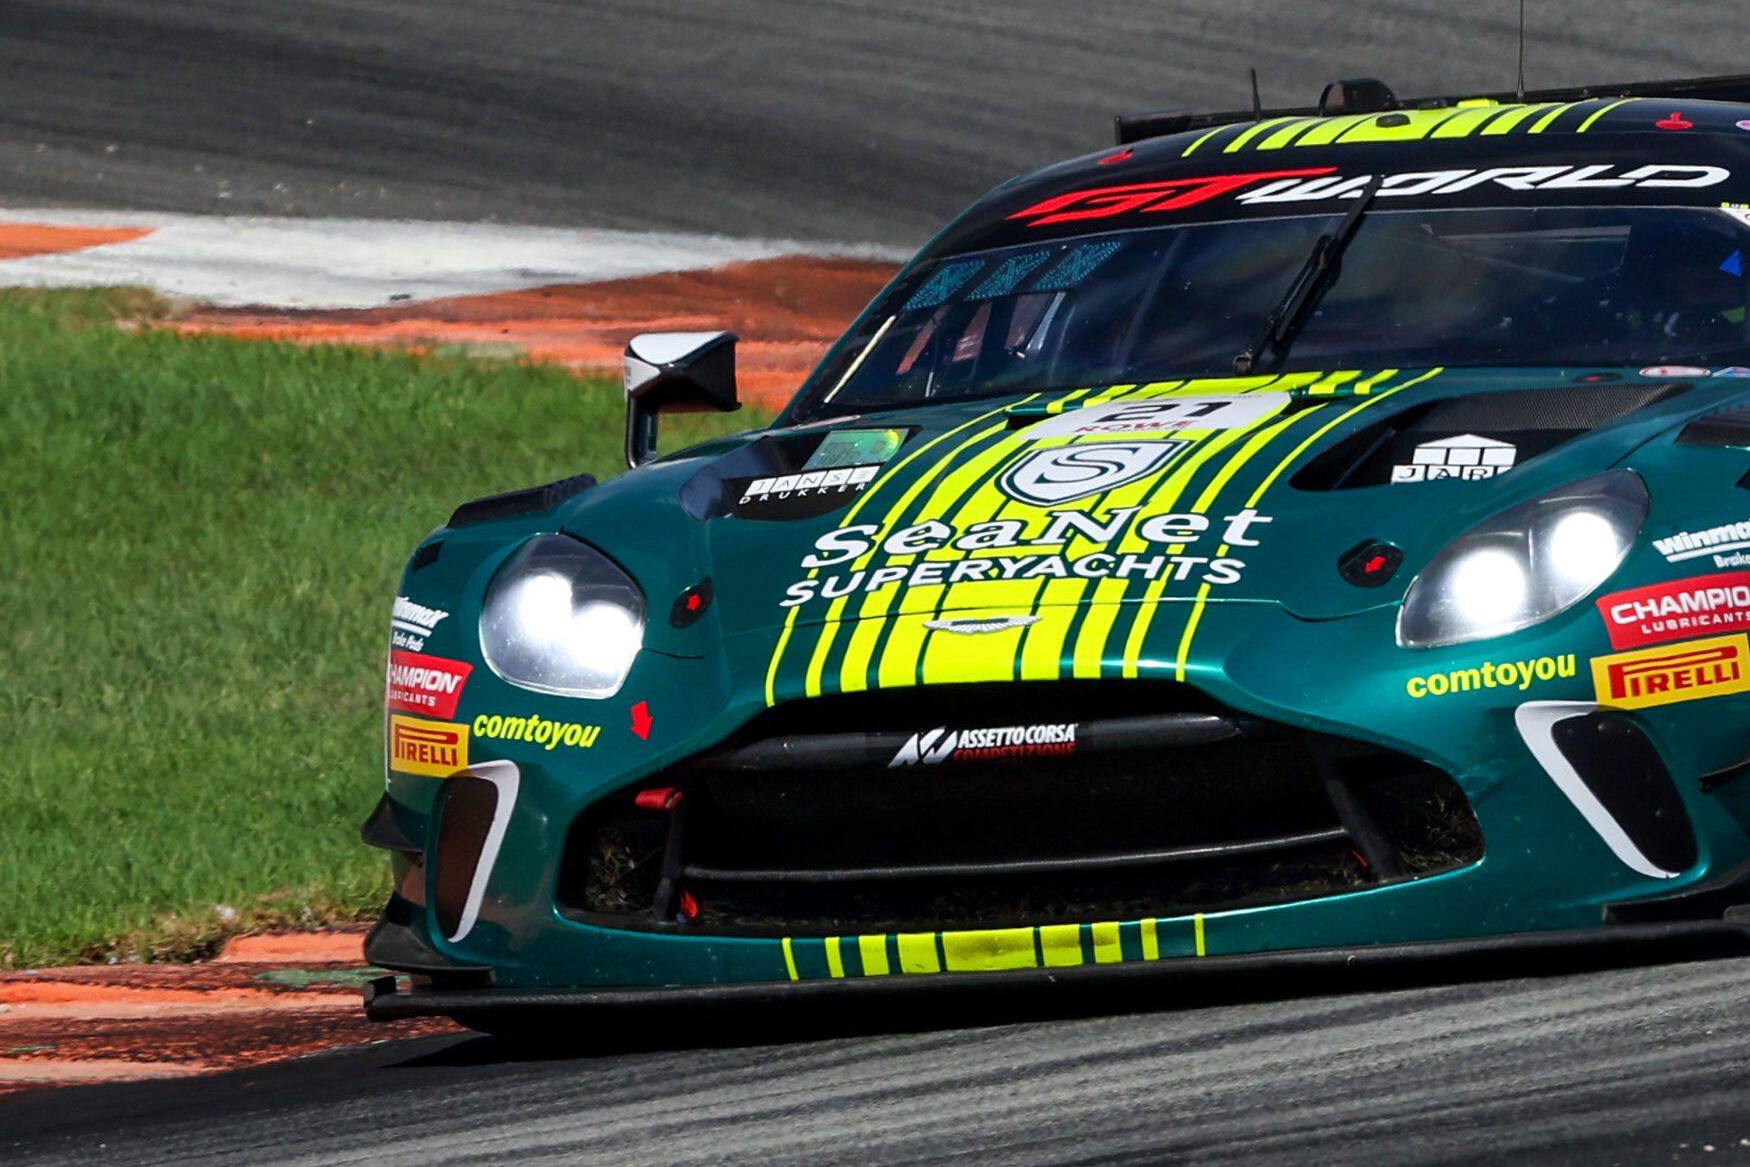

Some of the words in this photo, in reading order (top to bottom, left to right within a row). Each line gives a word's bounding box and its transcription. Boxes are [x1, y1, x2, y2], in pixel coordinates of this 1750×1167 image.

[1005, 167, 1339, 227] GT
[1236, 165, 1730, 205] WORLD
[1093, 401, 1233, 423] 21
[738, 483, 866, 504] DRUKKER
[800, 506, 1273, 571] SeaNet
[779, 553, 1246, 608] SUPERYACHTS
[1406, 654, 1577, 698] comtoyou
[1608, 646, 1740, 699] PIRELLI
[394, 724, 459, 766] PIRELLI
[473, 713, 600, 751] comtoyou
[958, 727, 1026, 749] ASSETTO
[1025, 724, 1075, 745] CORSA
